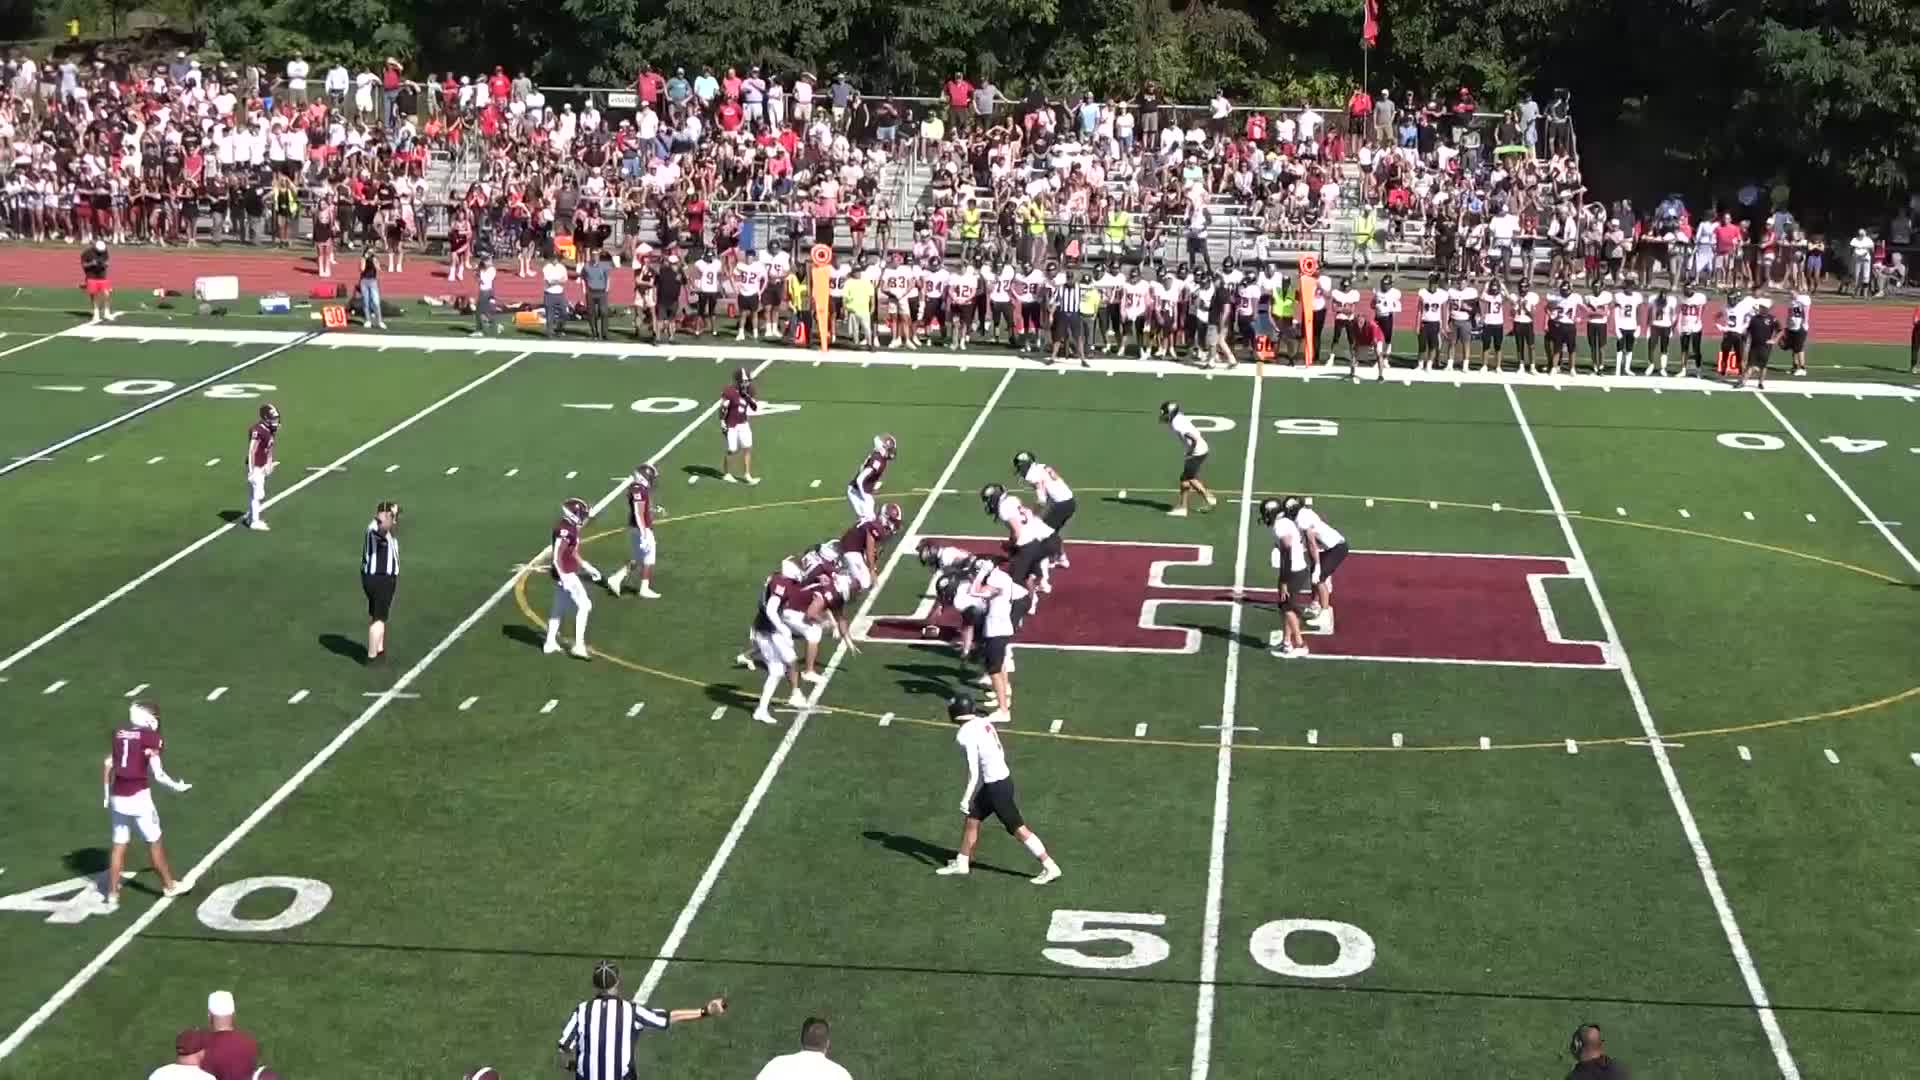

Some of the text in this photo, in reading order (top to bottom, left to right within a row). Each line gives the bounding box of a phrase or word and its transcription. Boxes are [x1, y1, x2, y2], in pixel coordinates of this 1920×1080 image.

[325, 308, 344, 324] 30
[1624, 304, 1633, 318] 2
[120, 738, 129, 768] 1
[1041, 909, 1377, 979] 50
